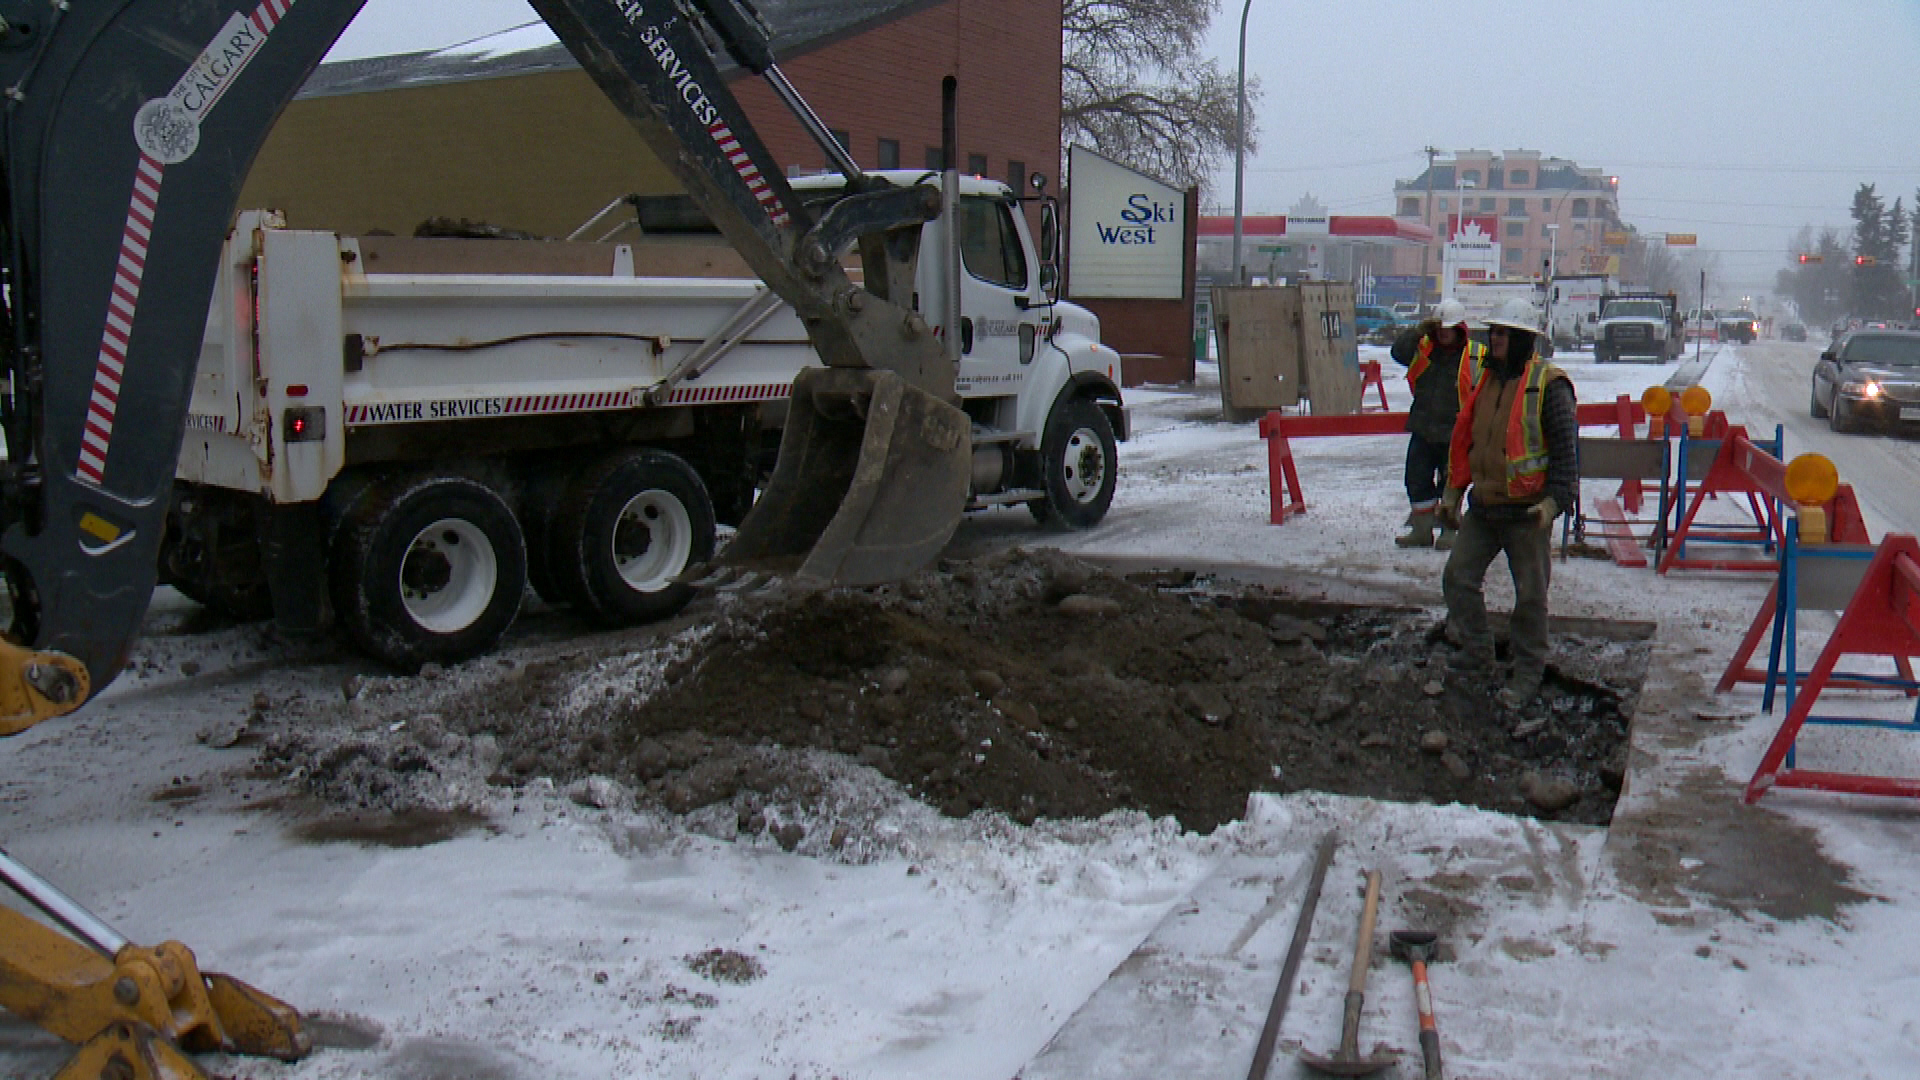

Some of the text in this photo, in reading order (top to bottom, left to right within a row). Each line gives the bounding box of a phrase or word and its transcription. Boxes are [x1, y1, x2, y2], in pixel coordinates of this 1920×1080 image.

[183, 23, 256, 111] CALGARY
[640, 25, 717, 125] SERVICES
[1121, 193, 1175, 226] Ski
[1096, 221, 1156, 245] West
[369, 398, 501, 421] WATER SERVICES
